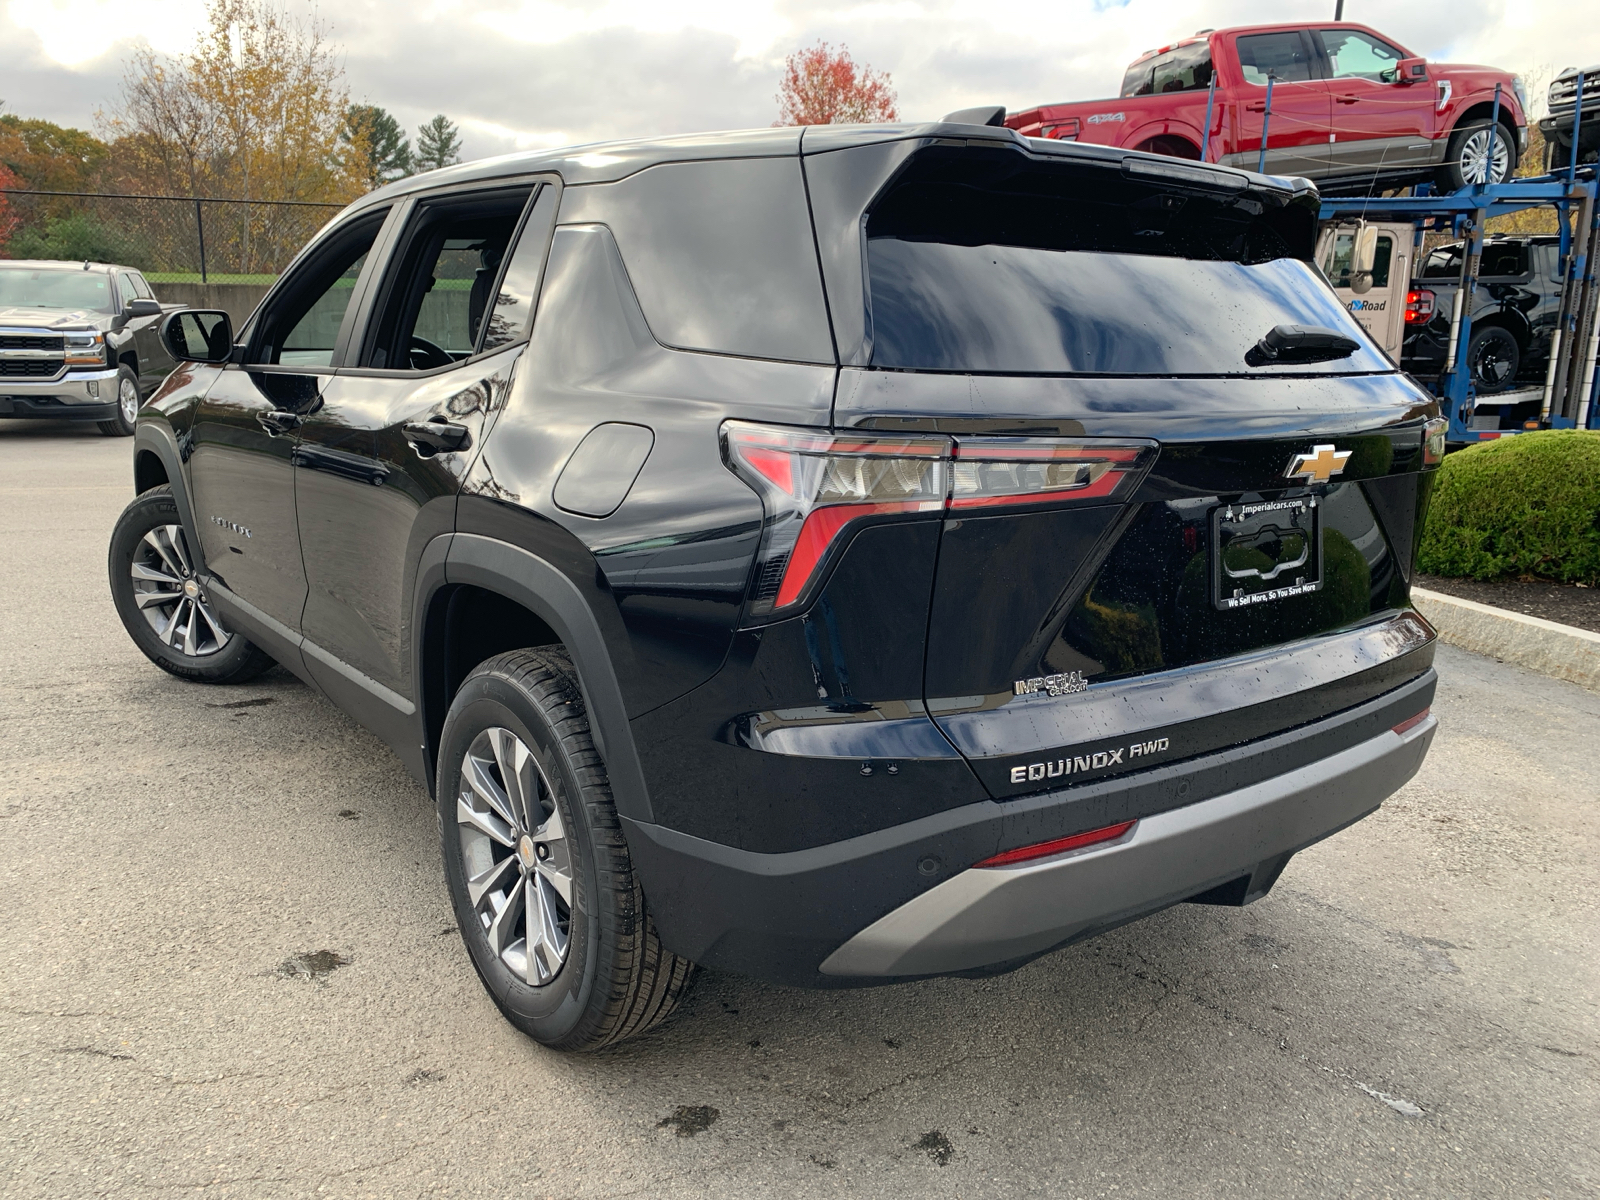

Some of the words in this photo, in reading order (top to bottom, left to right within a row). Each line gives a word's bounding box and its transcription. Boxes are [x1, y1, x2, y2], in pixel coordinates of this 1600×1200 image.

[1361, 300, 1387, 311] Road
[1242, 501, 1302, 514] Imperialcars.com
[1228, 599, 1239, 608] We
[1239, 596, 1251, 606] Sell
[1251, 594, 1268, 603] More,
[1268, 591, 1277, 600] So
[1277, 588, 1288, 598] You
[1288, 586, 1302, 596] Save
[1302, 584, 1316, 593] More
[1014, 670, 1085, 695] IMPERIAL
[1048, 679, 1089, 697] cars.com
[1010, 748, 1125, 783] EQUINOX
[1129, 737, 1169, 759] AWD
